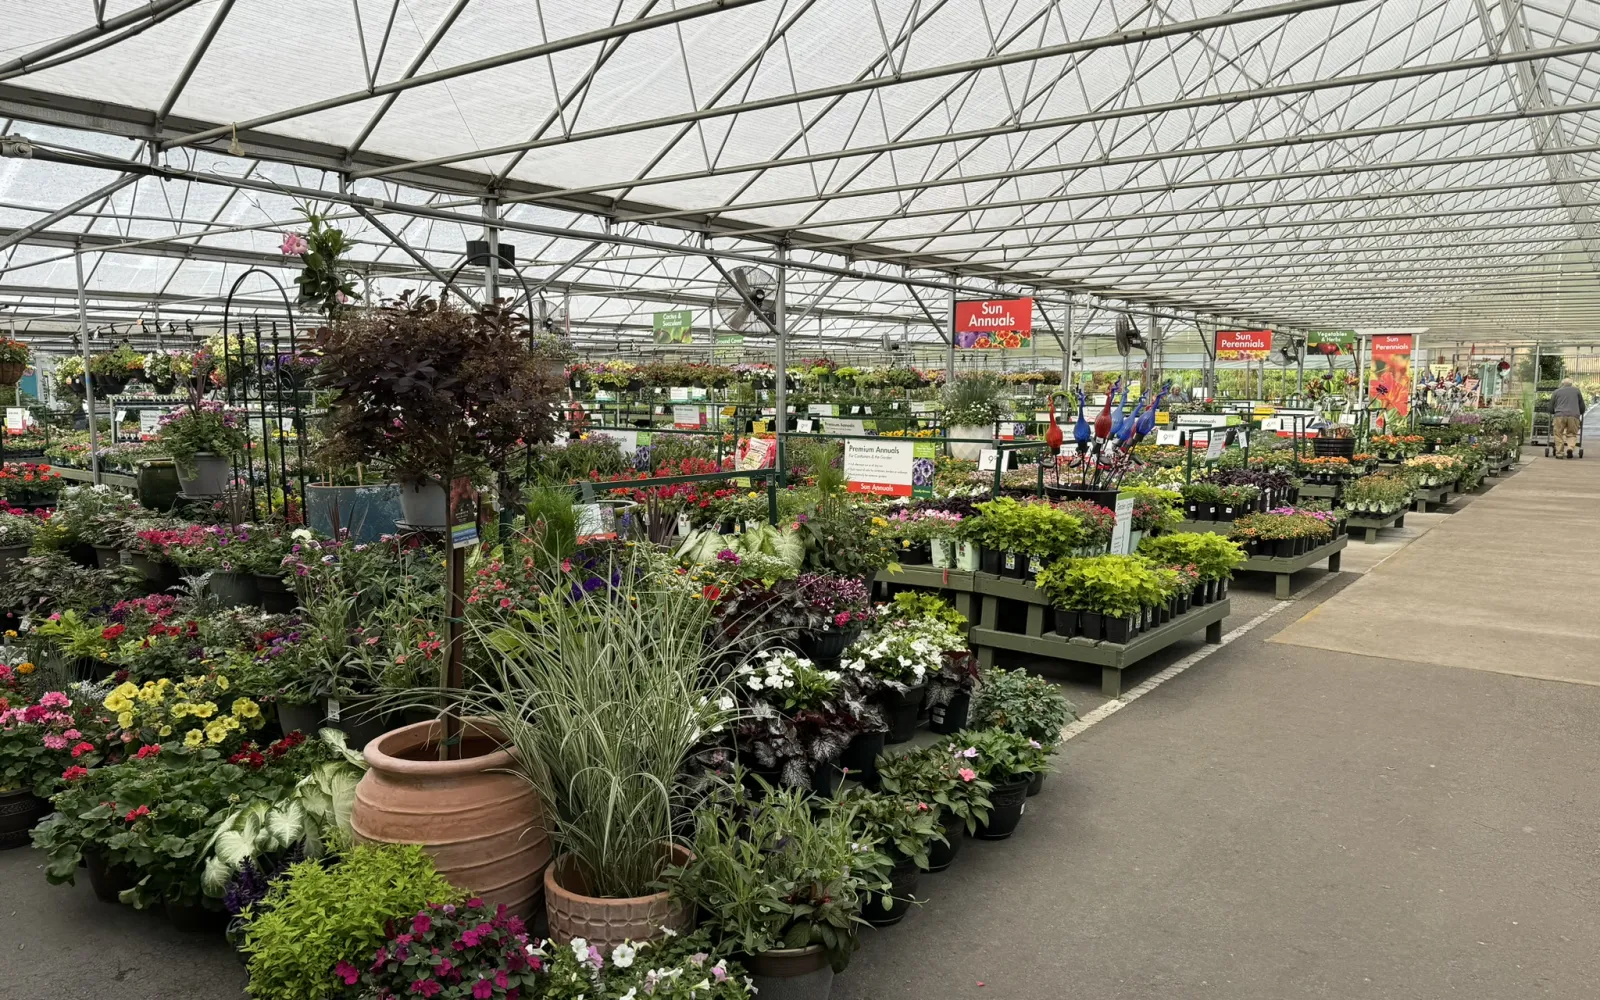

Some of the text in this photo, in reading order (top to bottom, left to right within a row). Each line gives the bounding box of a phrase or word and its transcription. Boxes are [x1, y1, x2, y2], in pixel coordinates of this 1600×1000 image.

[981, 302, 1003, 314] Sun
[968, 312, 1015, 327] Annuals
[1235, 332, 1251, 340] Sun
[1221, 339, 1265, 348] Perennials
[849, 445, 900, 454] Premium Annuals
[860, 482, 894, 492] Sun Annuals
